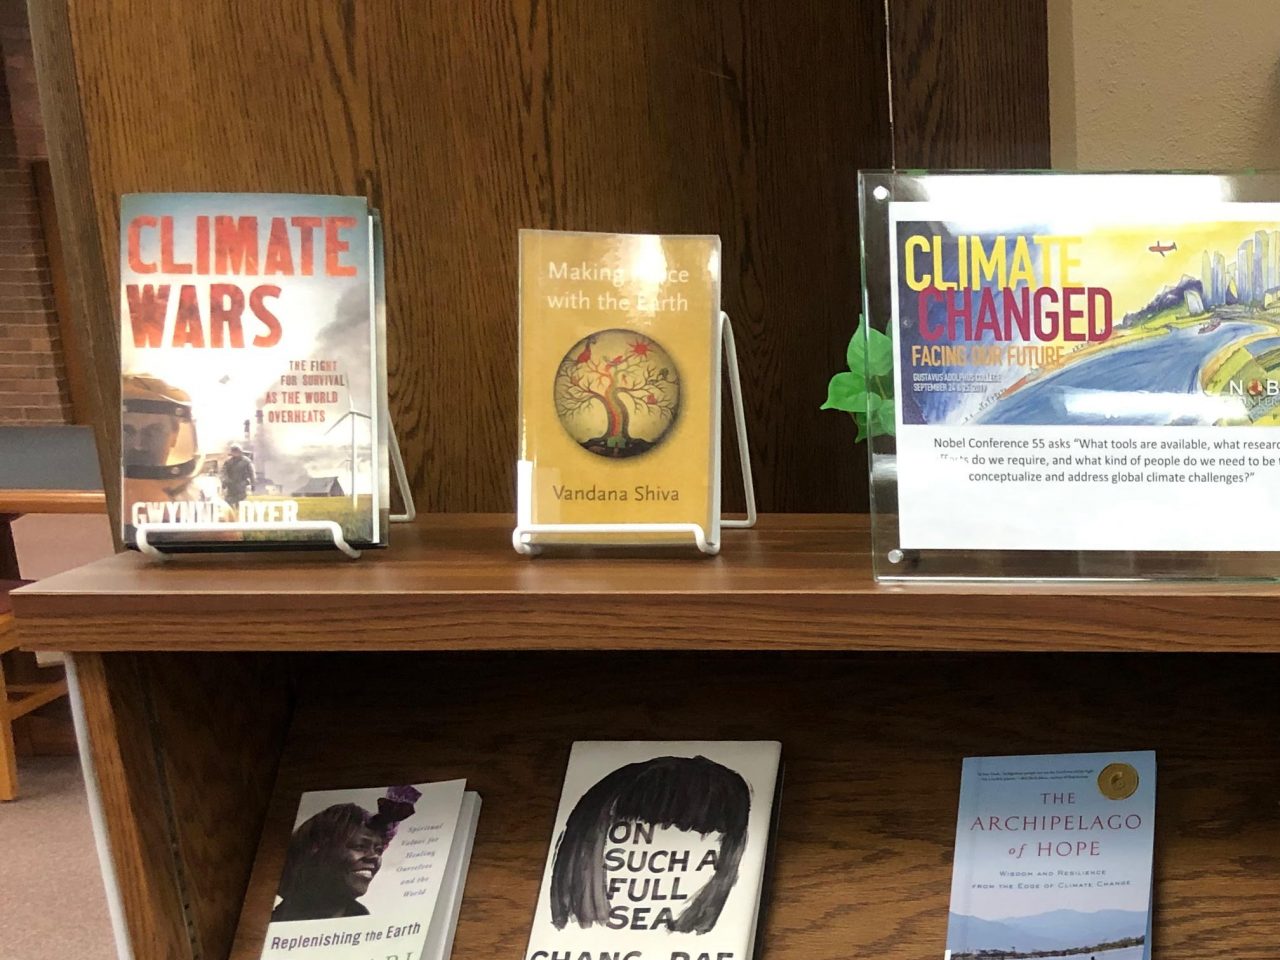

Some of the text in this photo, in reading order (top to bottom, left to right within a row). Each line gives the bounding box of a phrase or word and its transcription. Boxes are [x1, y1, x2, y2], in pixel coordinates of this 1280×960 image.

[128, 216, 357, 277] CLIMATE
[904, 234, 1083, 291] CLIMATE
[548, 261, 625, 288] Making
[547, 291, 630, 312] with the
[126, 283, 282, 348] WARS
[917, 286, 1114, 342] CHANGED
[289, 360, 337, 371] THE FIGHT
[911, 345, 1065, 367] FACING OUR FUTURE
[280, 374, 345, 386] FOR SURVIVAL
[265, 391, 338, 404] AS THE WORLD
[268, 410, 325, 423] OVERHEATS
[934, 438, 965, 449] Nobel
[968, 438, 1029, 449] Conference
[1032, 438, 1045, 448] 55
[1048, 438, 1071, 449] asks
[1074, 438, 1108, 449] “What
[1111, 439, 1137, 449] tools
[1140, 441, 1157, 449] are
[1160, 439, 1210, 451] available,
[1213, 439, 1240, 450] what
[968, 472, 1042, 484] conceptualize
[1045, 472, 1065, 482] and
[1068, 472, 1109, 482] address
[1112, 472, 1144, 485] global
[1147, 472, 1185, 483] climate
[553, 485, 679, 501] Vandana Shiva
[1040, 792, 1076, 805] THE
[609, 821, 654, 845] ON
[970, 813, 1142, 832] ARCHIPELAGO
[1008, 841, 1101, 858] of HOPE
[603, 848, 720, 873] SUCH A
[606, 877, 688, 901] FULL
[606, 906, 676, 931] SEA
[271, 922, 421, 951] Replenishing the Earth
